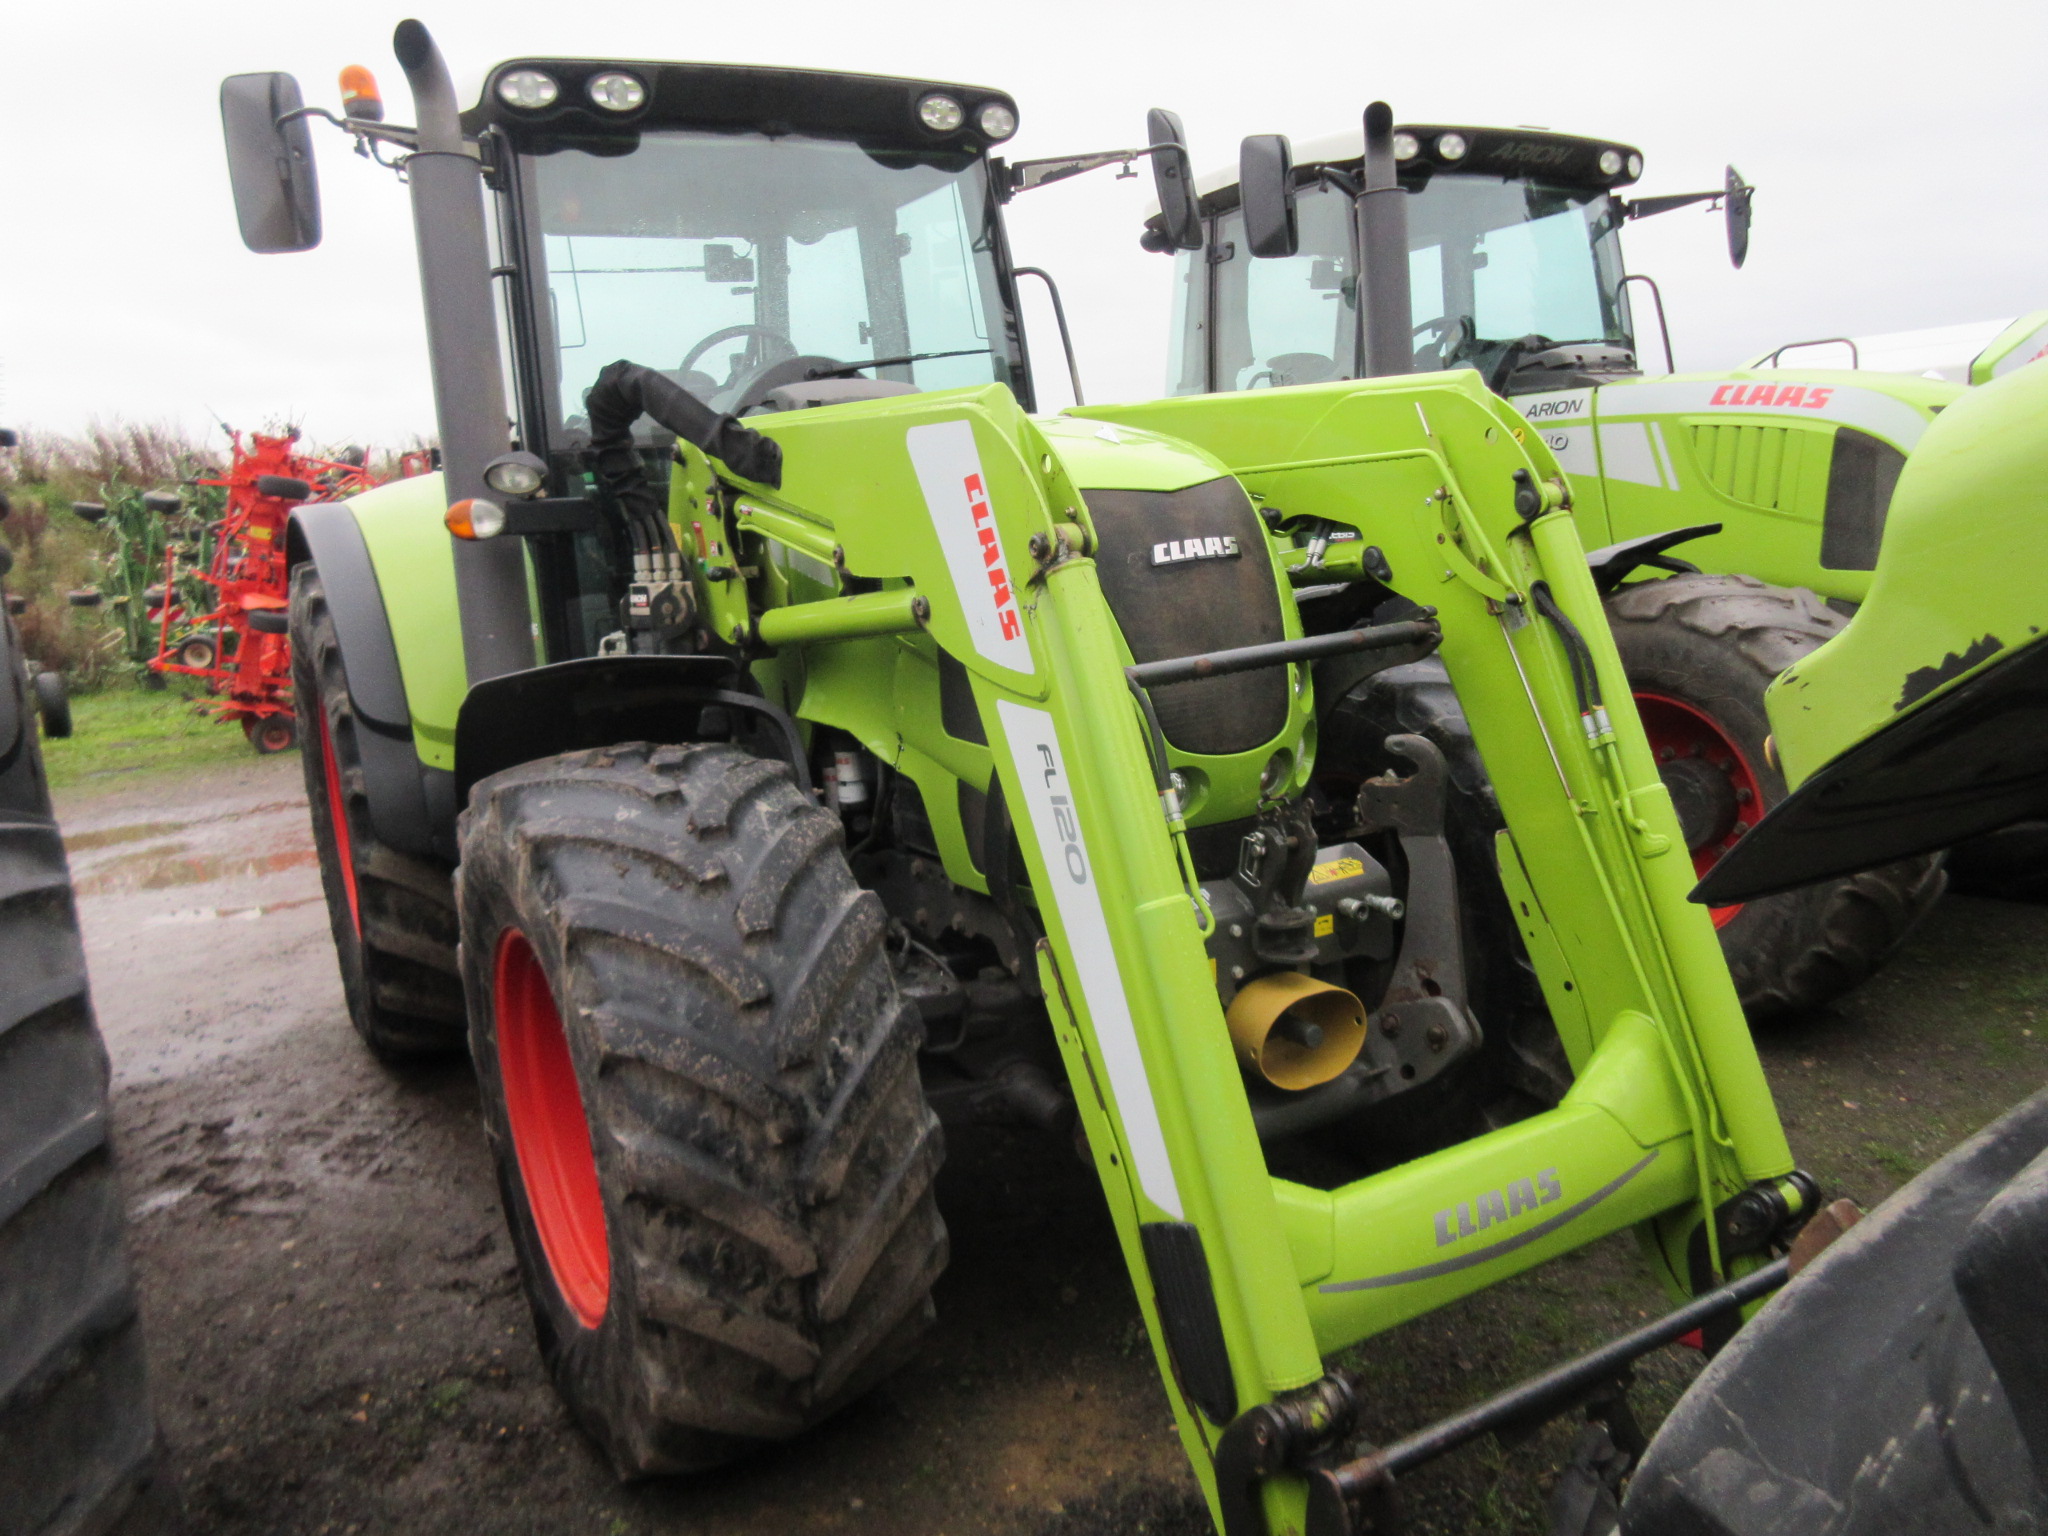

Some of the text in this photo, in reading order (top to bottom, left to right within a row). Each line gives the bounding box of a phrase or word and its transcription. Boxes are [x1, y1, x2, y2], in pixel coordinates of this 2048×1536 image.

[1488, 141, 1574, 165] ARION
[1525, 399, 1584, 419] ARION
[1709, 384, 1835, 409] CLAAS
[963, 473, 1021, 641] CLAAS
[1153, 536, 1240, 565] CLAAS
[1433, 1166, 1562, 1248] CLAAS
